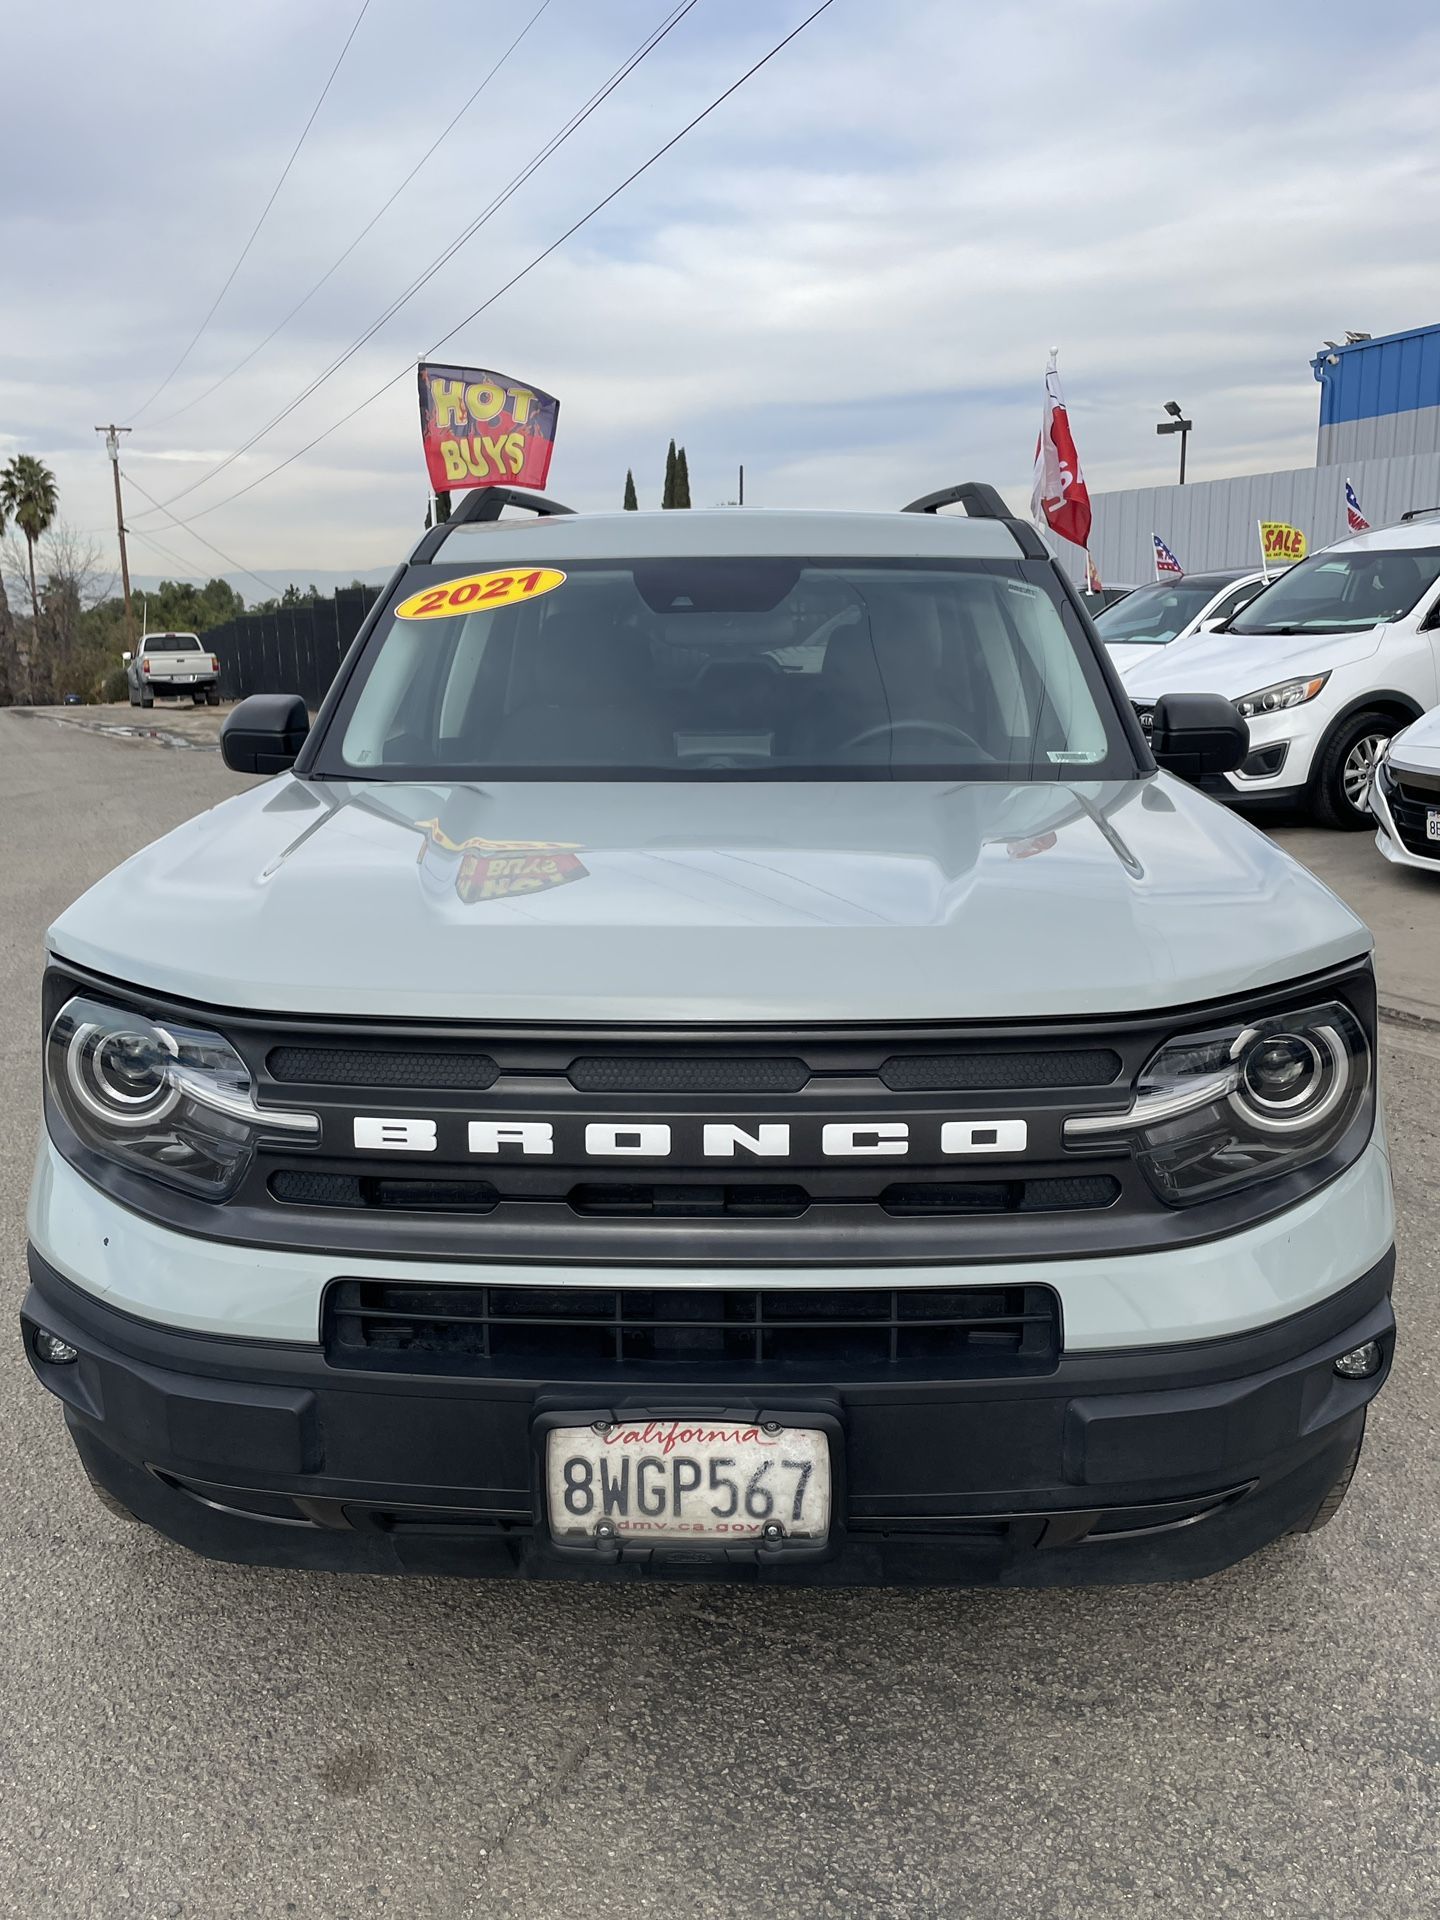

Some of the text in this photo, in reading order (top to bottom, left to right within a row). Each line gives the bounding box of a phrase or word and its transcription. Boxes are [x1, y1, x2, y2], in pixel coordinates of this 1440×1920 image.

[431, 378, 537, 428] HOT
[440, 432, 525, 481] BUYS
[1265, 529, 1302, 552] SALE
[413, 571, 543, 615] 2021
[354, 1117, 1027, 1155] BRONCO
[603, 1421, 776, 1455] California
[563, 1455, 815, 1521] 8WGP567
[617, 1520, 760, 1533] dmv.ca.gov
